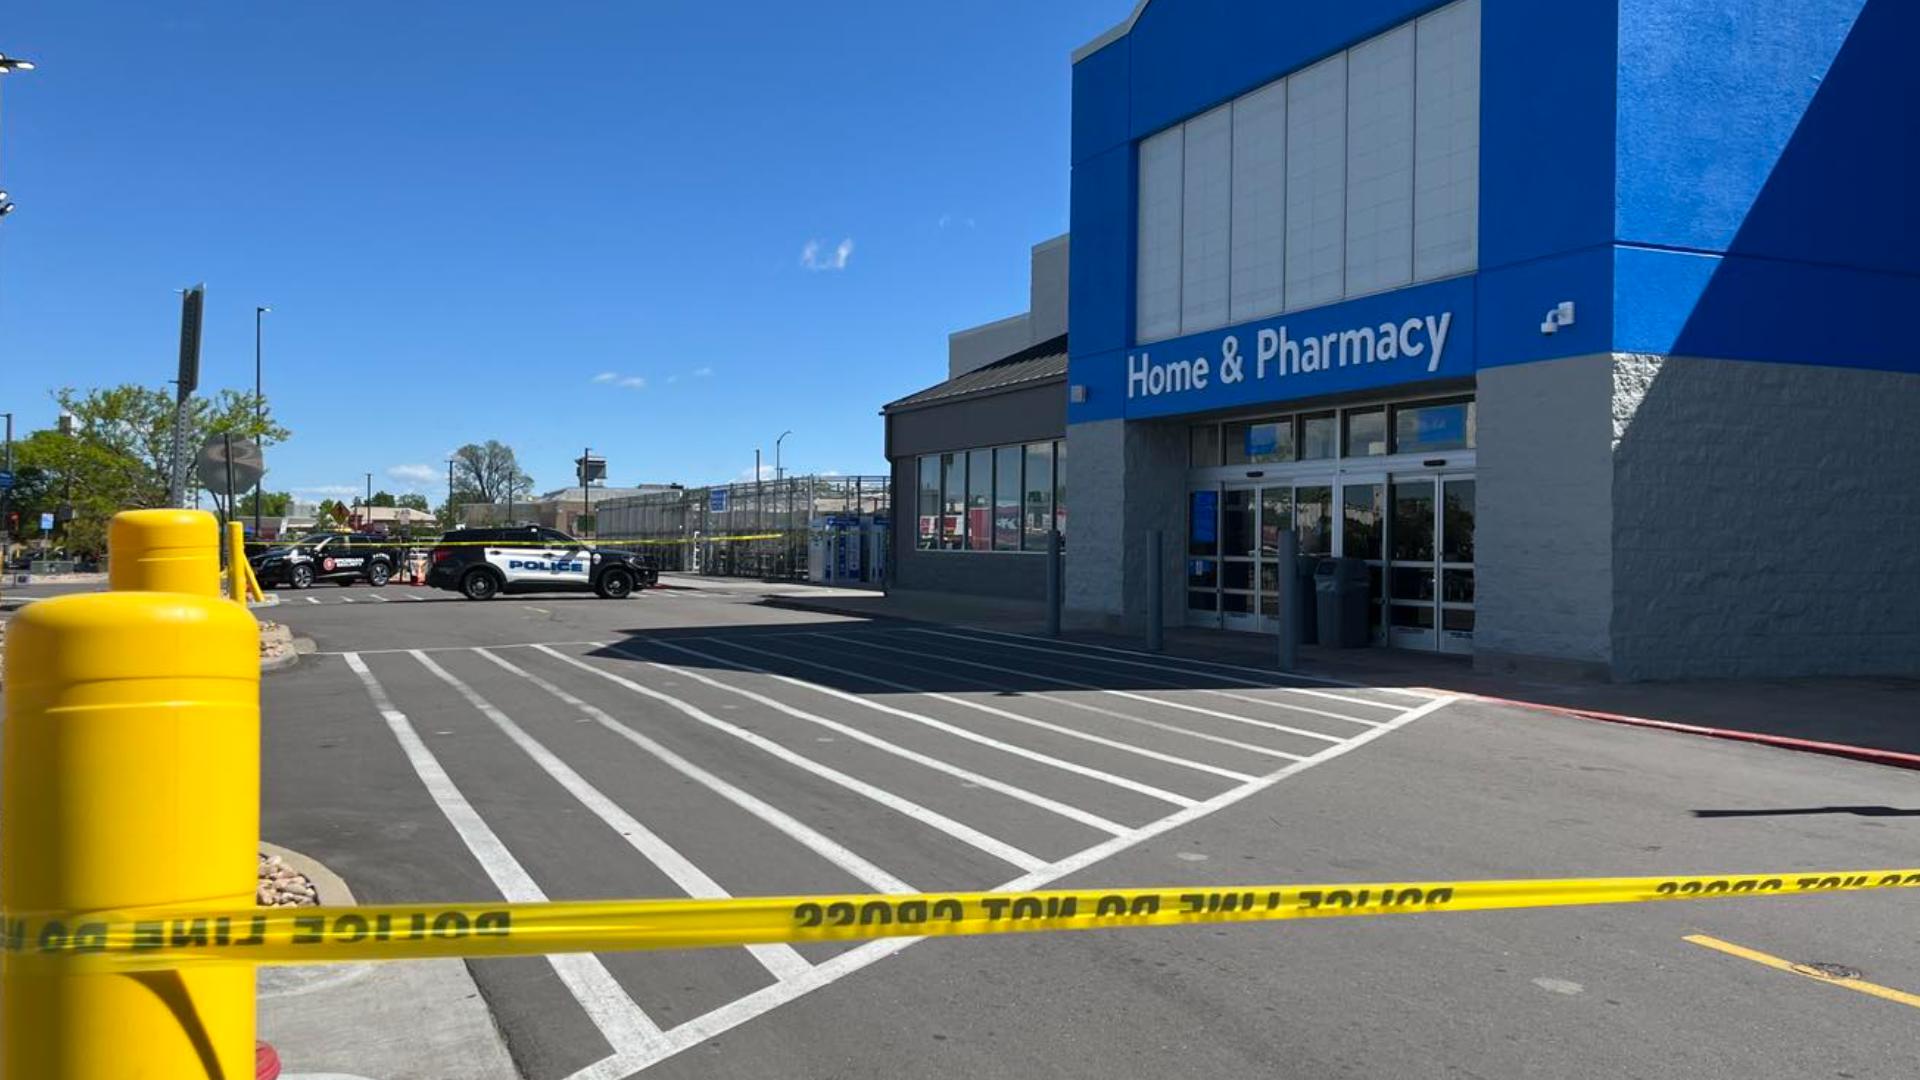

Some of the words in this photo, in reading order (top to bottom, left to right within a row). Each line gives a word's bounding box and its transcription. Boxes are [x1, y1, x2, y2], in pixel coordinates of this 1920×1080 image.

[1127, 352, 1208, 398] Home
[1219, 335, 1244, 385] &
[1256, 311, 1452, 379] Pharmacy
[508, 560, 583, 572] POLICE
